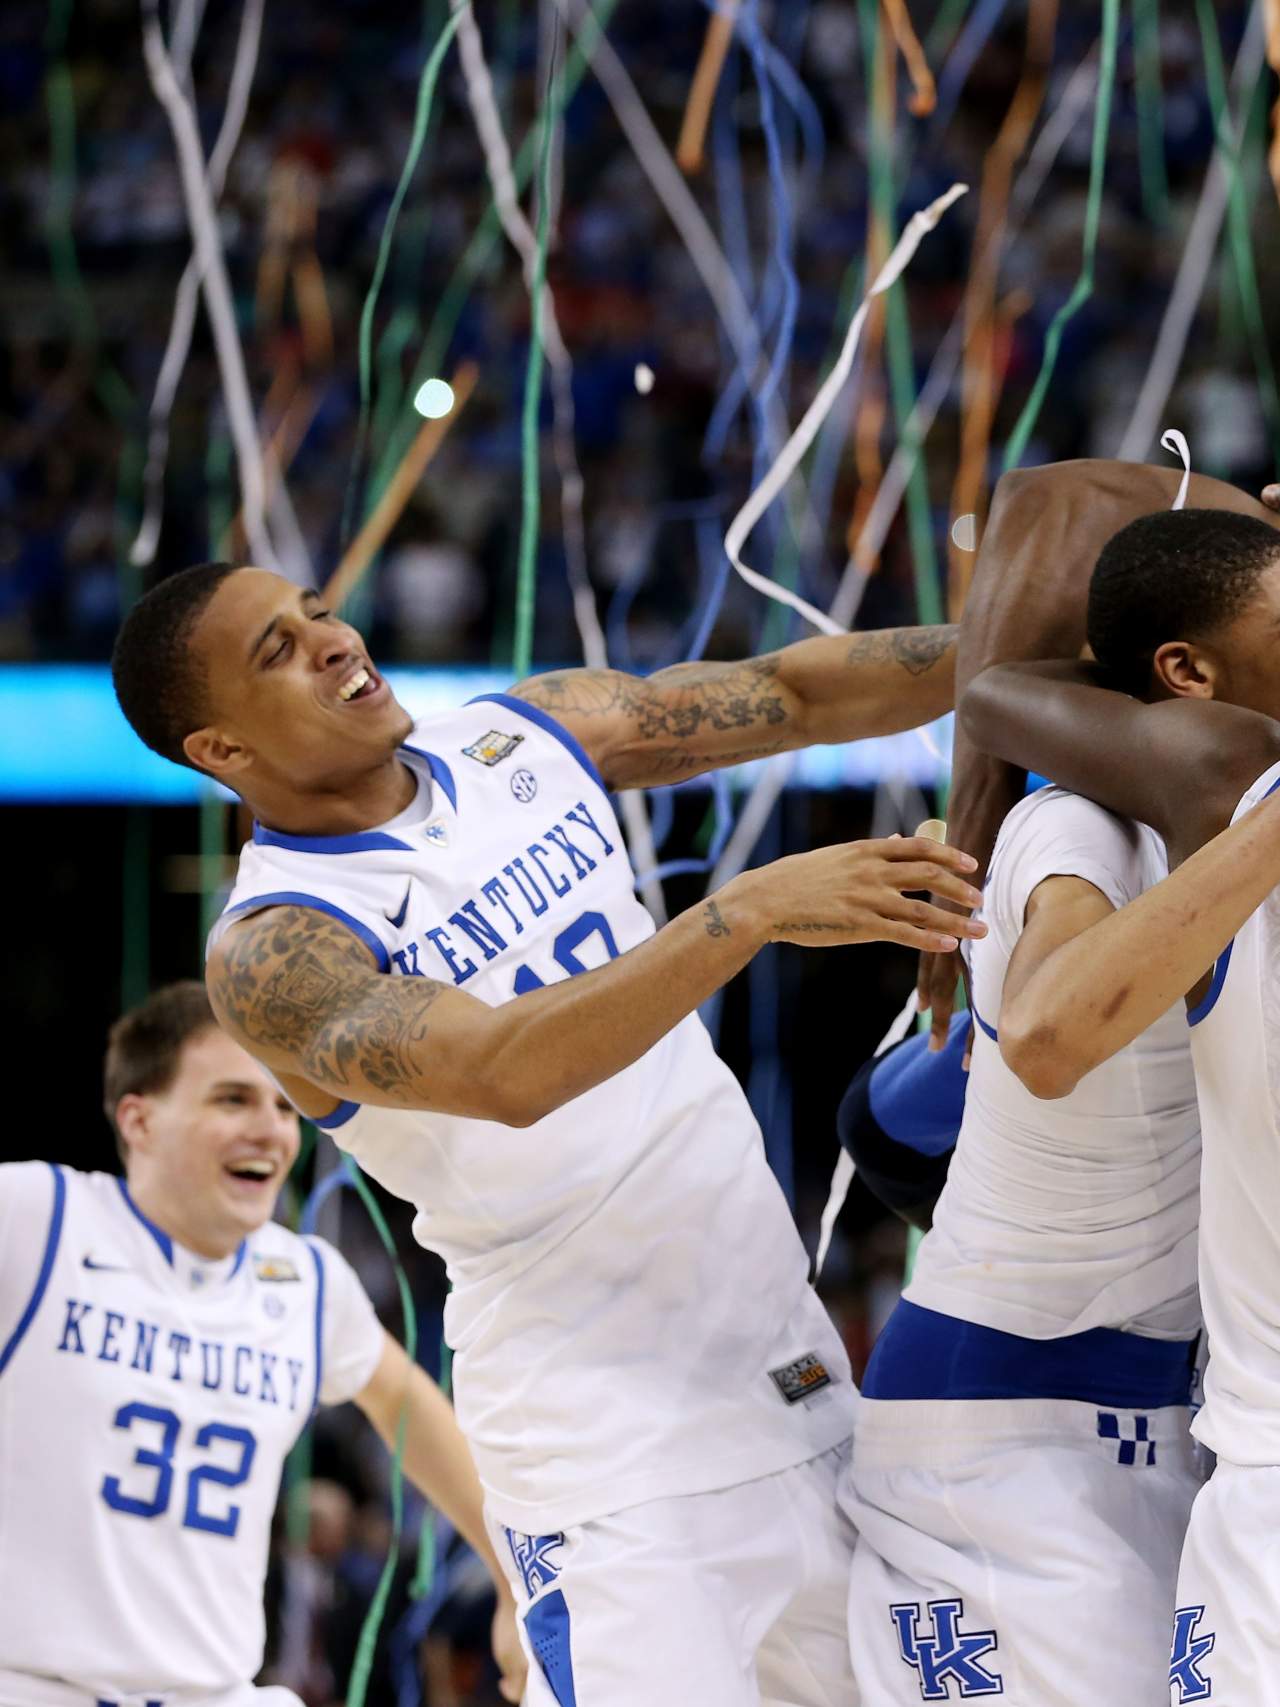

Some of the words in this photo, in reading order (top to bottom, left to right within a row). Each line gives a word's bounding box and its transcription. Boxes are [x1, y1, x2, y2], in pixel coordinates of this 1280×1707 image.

[392, 801, 614, 985] KENTUCKY
[56, 1299, 305, 1412] KENTUCKY
[101, 1401, 257, 1538] 32
[889, 1598, 1004, 1701] UK
